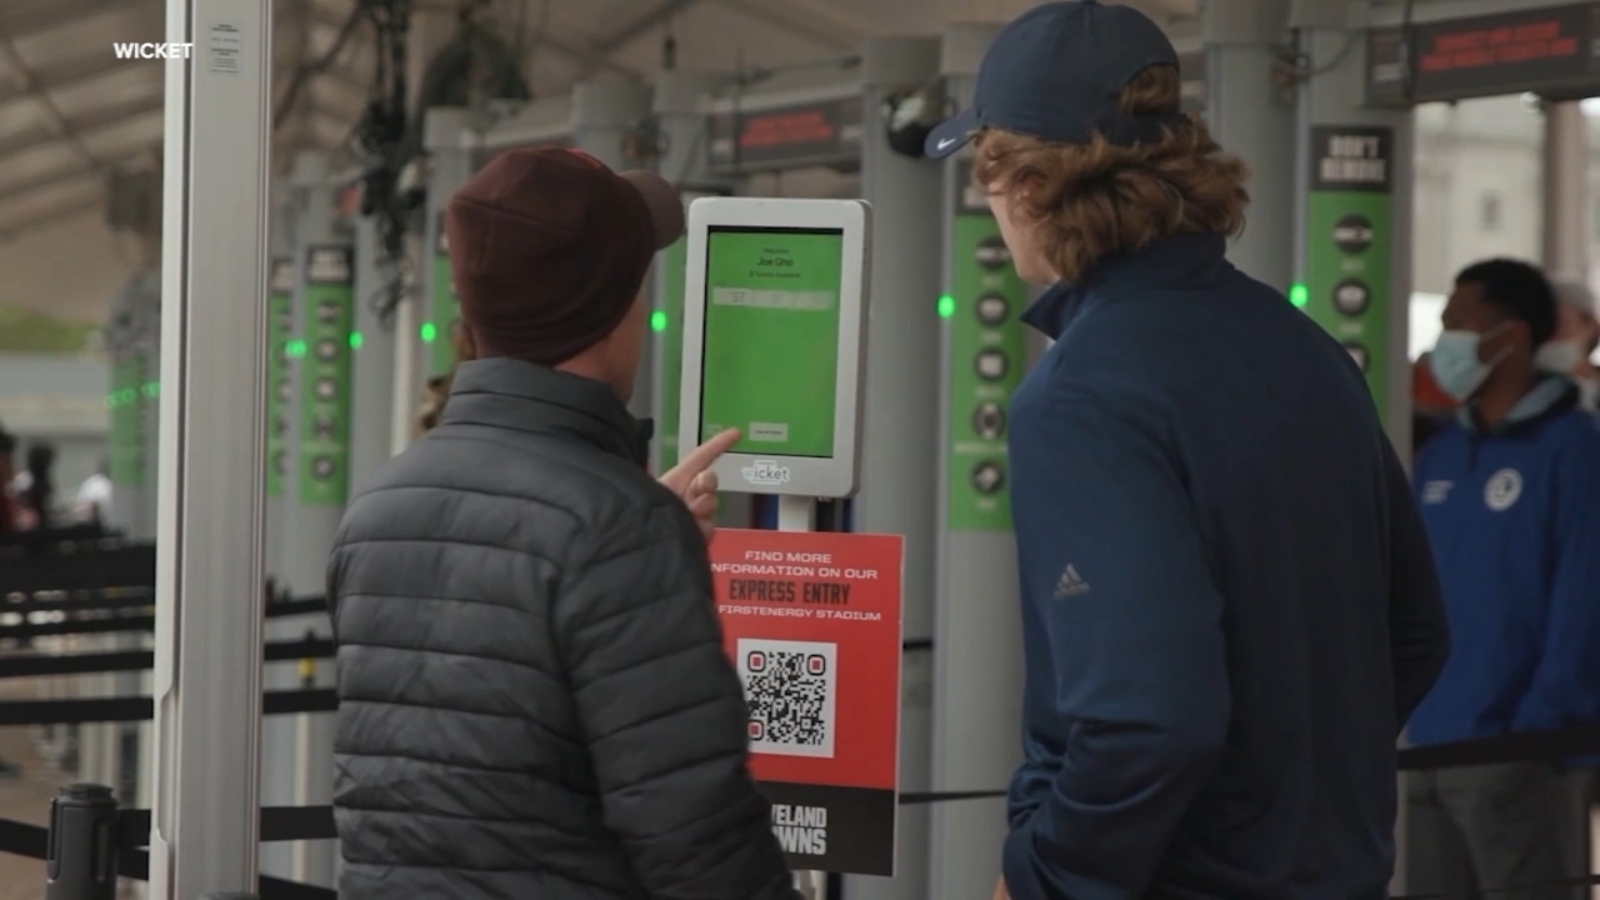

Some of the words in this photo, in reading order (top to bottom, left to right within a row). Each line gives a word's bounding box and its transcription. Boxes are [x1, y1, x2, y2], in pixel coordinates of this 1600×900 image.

[745, 550, 783, 562] FIND
[786, 552, 832, 564] MORE
[818, 567, 841, 578] ON
[844, 568, 878, 580] OUR
[729, 579, 795, 603] EXPRESS
[803, 582, 850, 605] ENTRY
[719, 605, 813, 618] FIRSTENERGY
[816, 609, 881, 621] STADIUM
[771, 826, 827, 856] WNS
